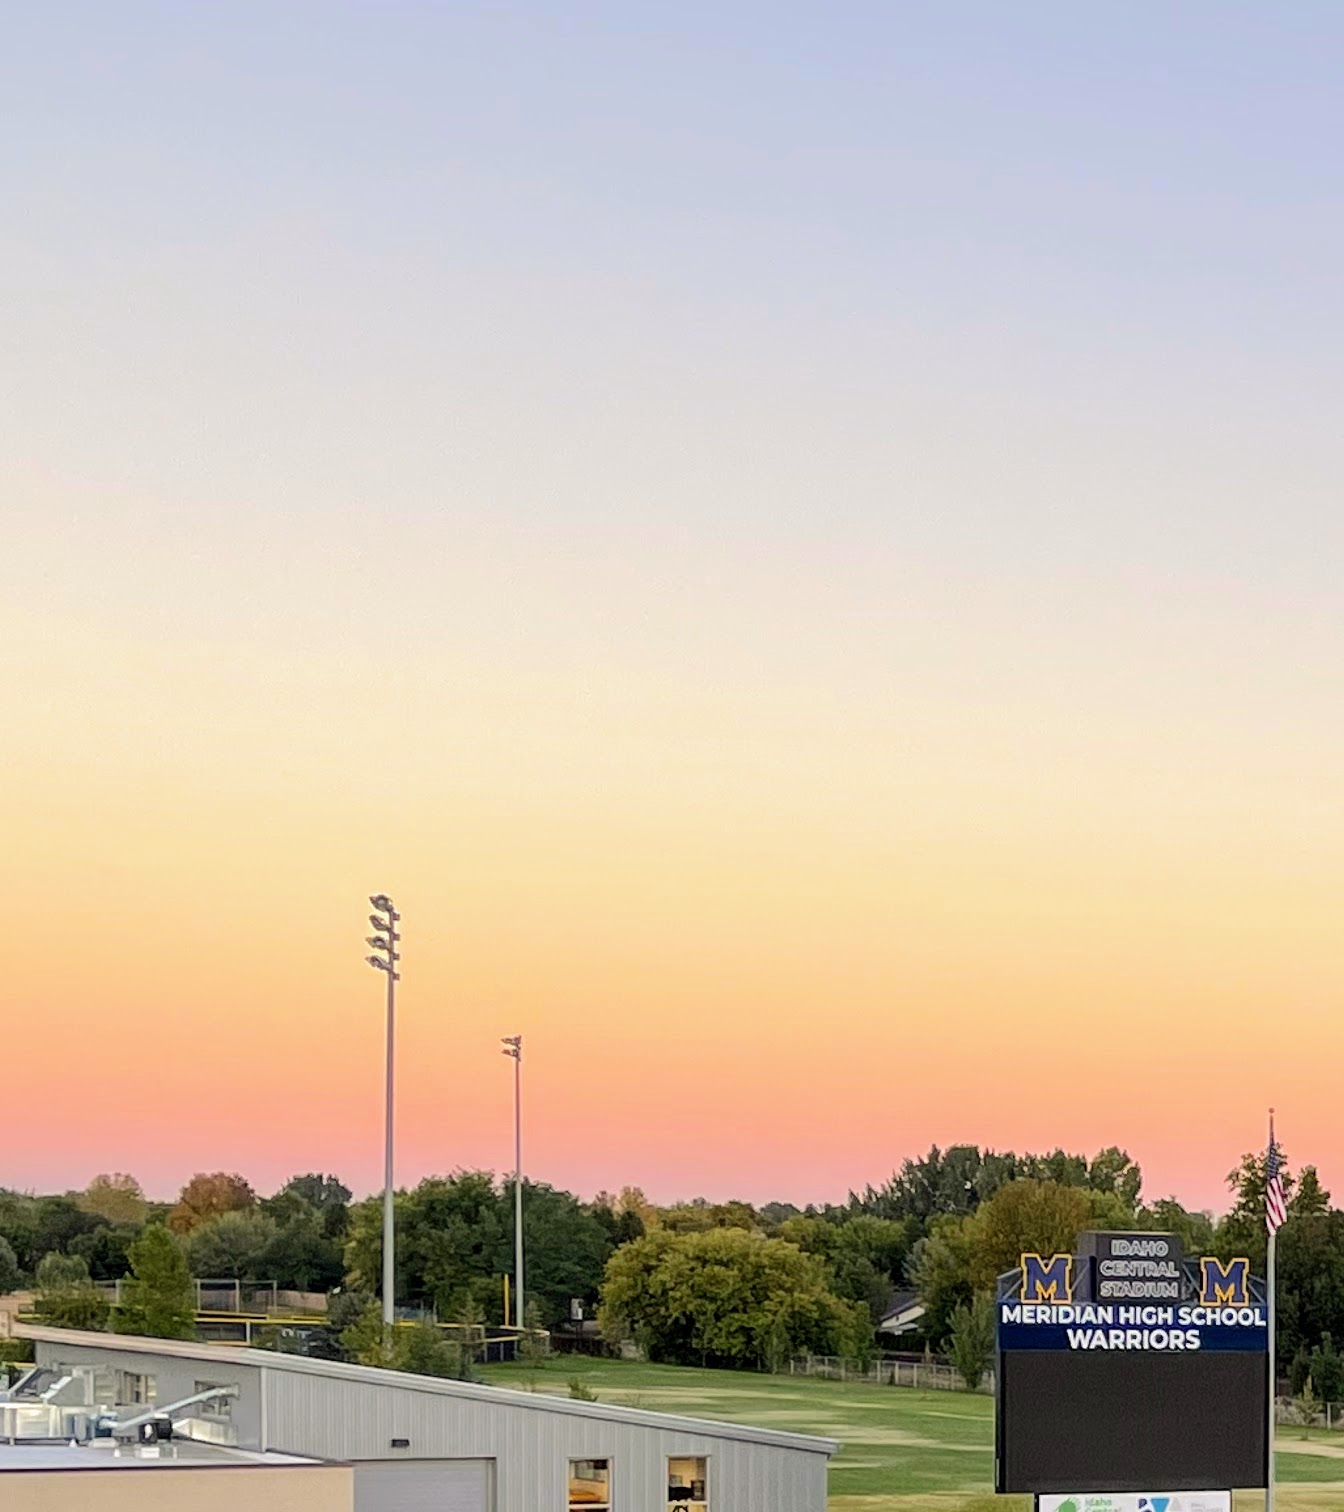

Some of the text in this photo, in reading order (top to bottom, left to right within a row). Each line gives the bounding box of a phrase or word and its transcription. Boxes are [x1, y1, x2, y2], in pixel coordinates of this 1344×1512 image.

[1110, 1239, 1168, 1257] IDAHO
[1020, 1253, 1072, 1304] M
[1099, 1261, 1179, 1278] CENTRAL
[1099, 1281, 1178, 1298] STADIUM
[1200, 1257, 1249, 1306] M
[1002, 1304, 1266, 1327] MERIDIAN HIGH SCHOOL
[1066, 1328, 1201, 1350] WARRIORS
